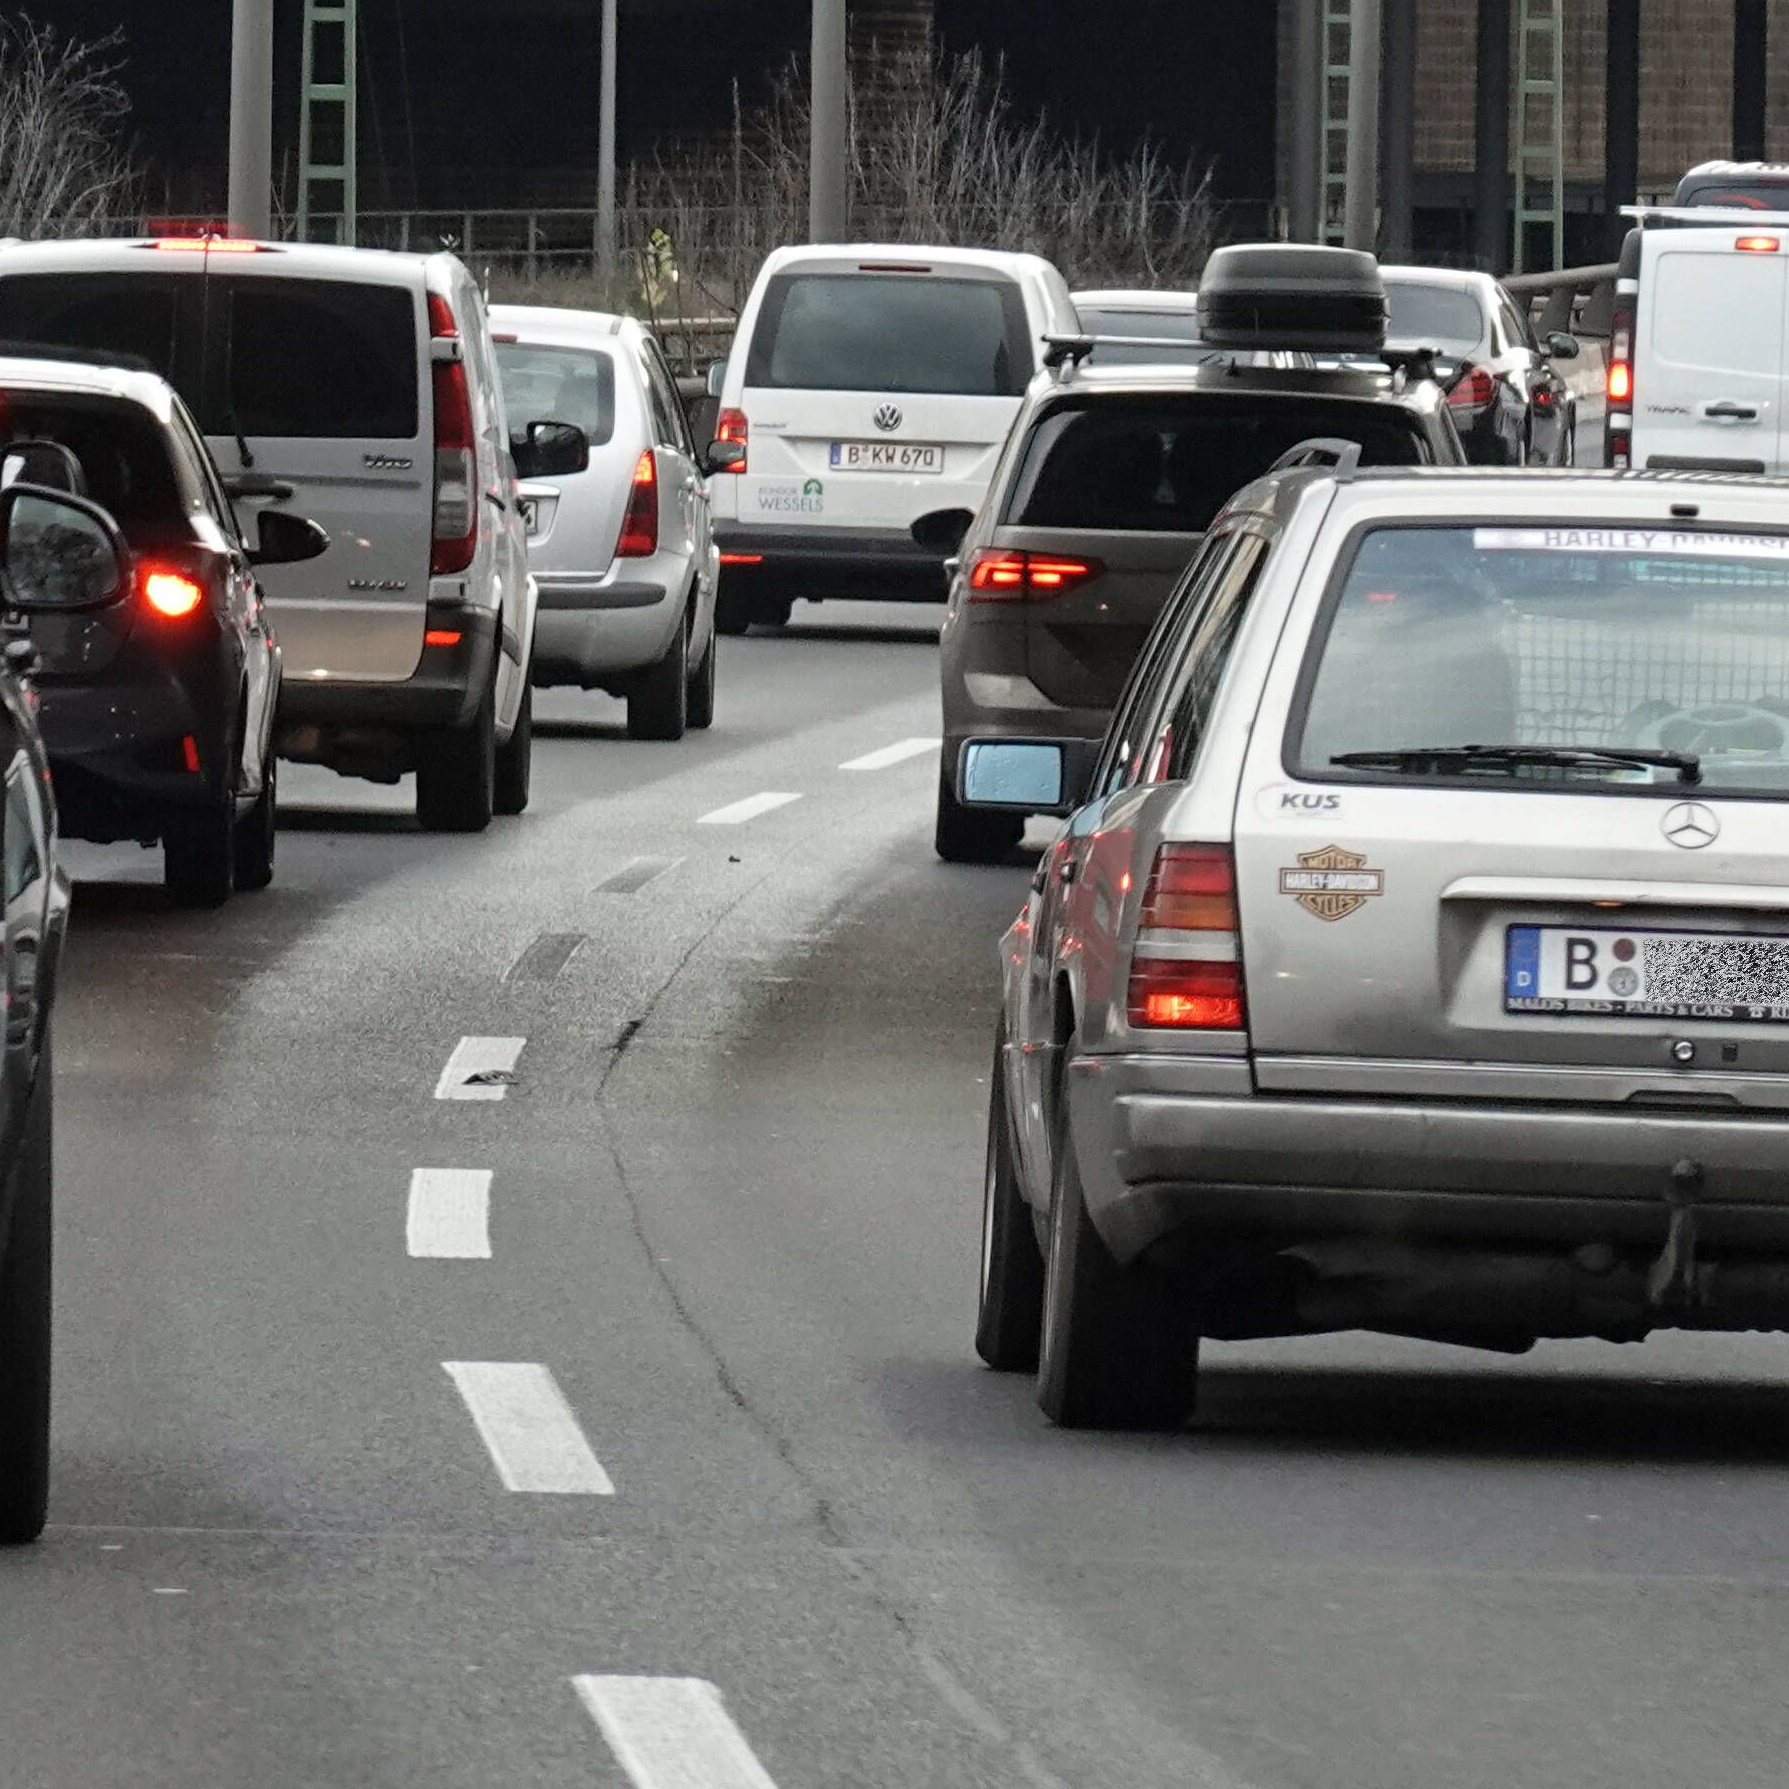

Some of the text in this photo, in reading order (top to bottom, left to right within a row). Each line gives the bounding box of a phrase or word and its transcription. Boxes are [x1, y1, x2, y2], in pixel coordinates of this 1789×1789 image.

[758, 496, 824, 513] WESSELS
[1564, 936, 1599, 991] B
[1691, 1004, 1734, 1018] CARS
